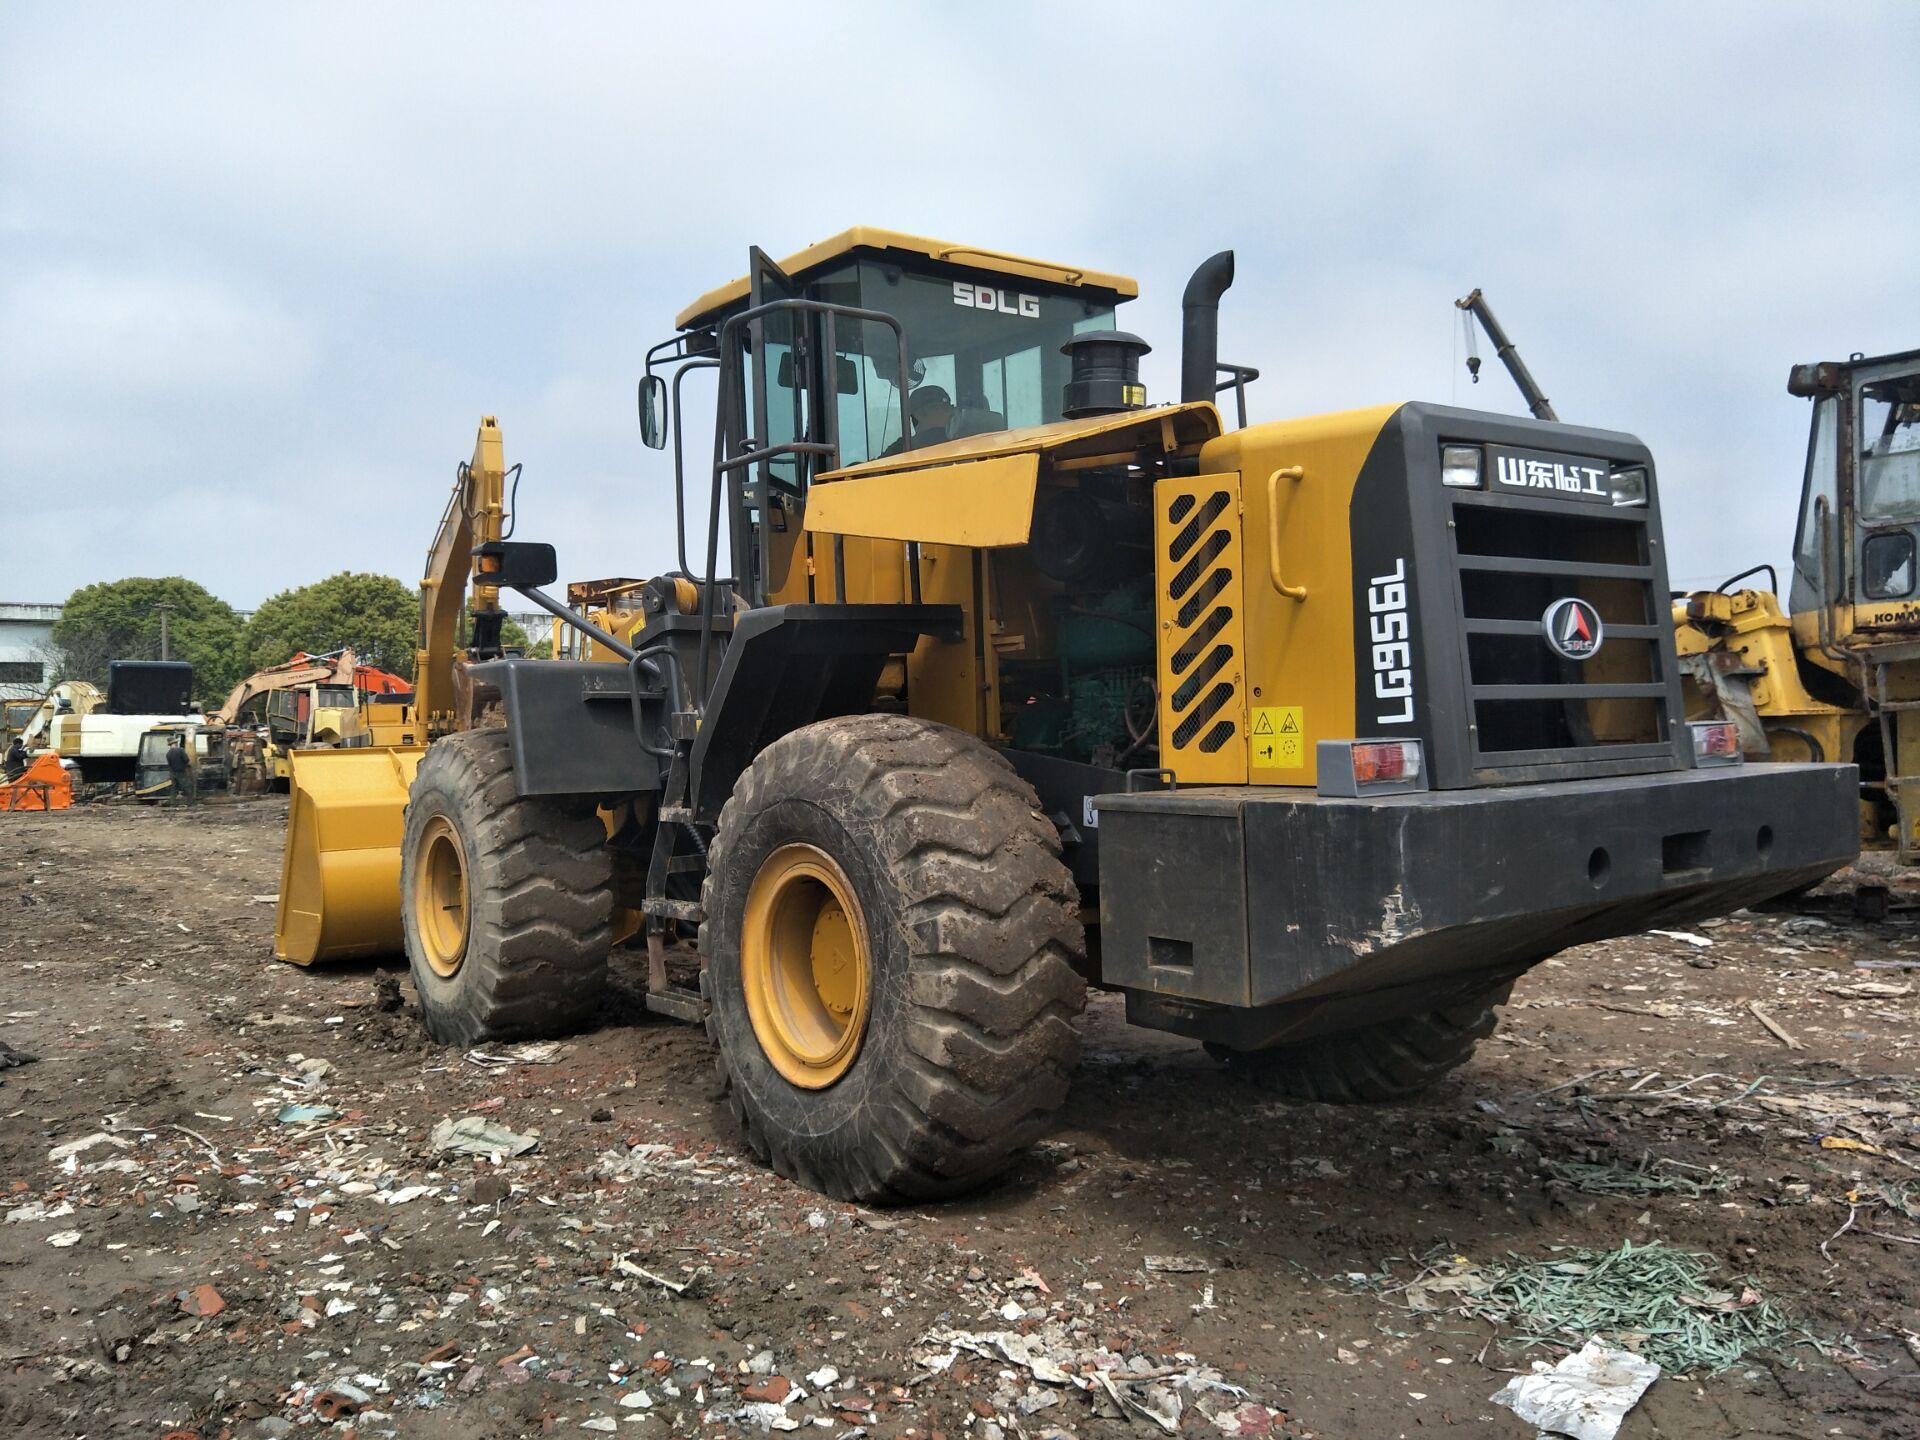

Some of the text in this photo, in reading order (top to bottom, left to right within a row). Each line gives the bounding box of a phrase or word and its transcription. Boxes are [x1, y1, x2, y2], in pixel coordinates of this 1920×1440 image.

[953, 281, 1040, 319] SDLG
[1497, 456, 1607, 496] 山东临工
[1368, 558, 1414, 724] LG956L
